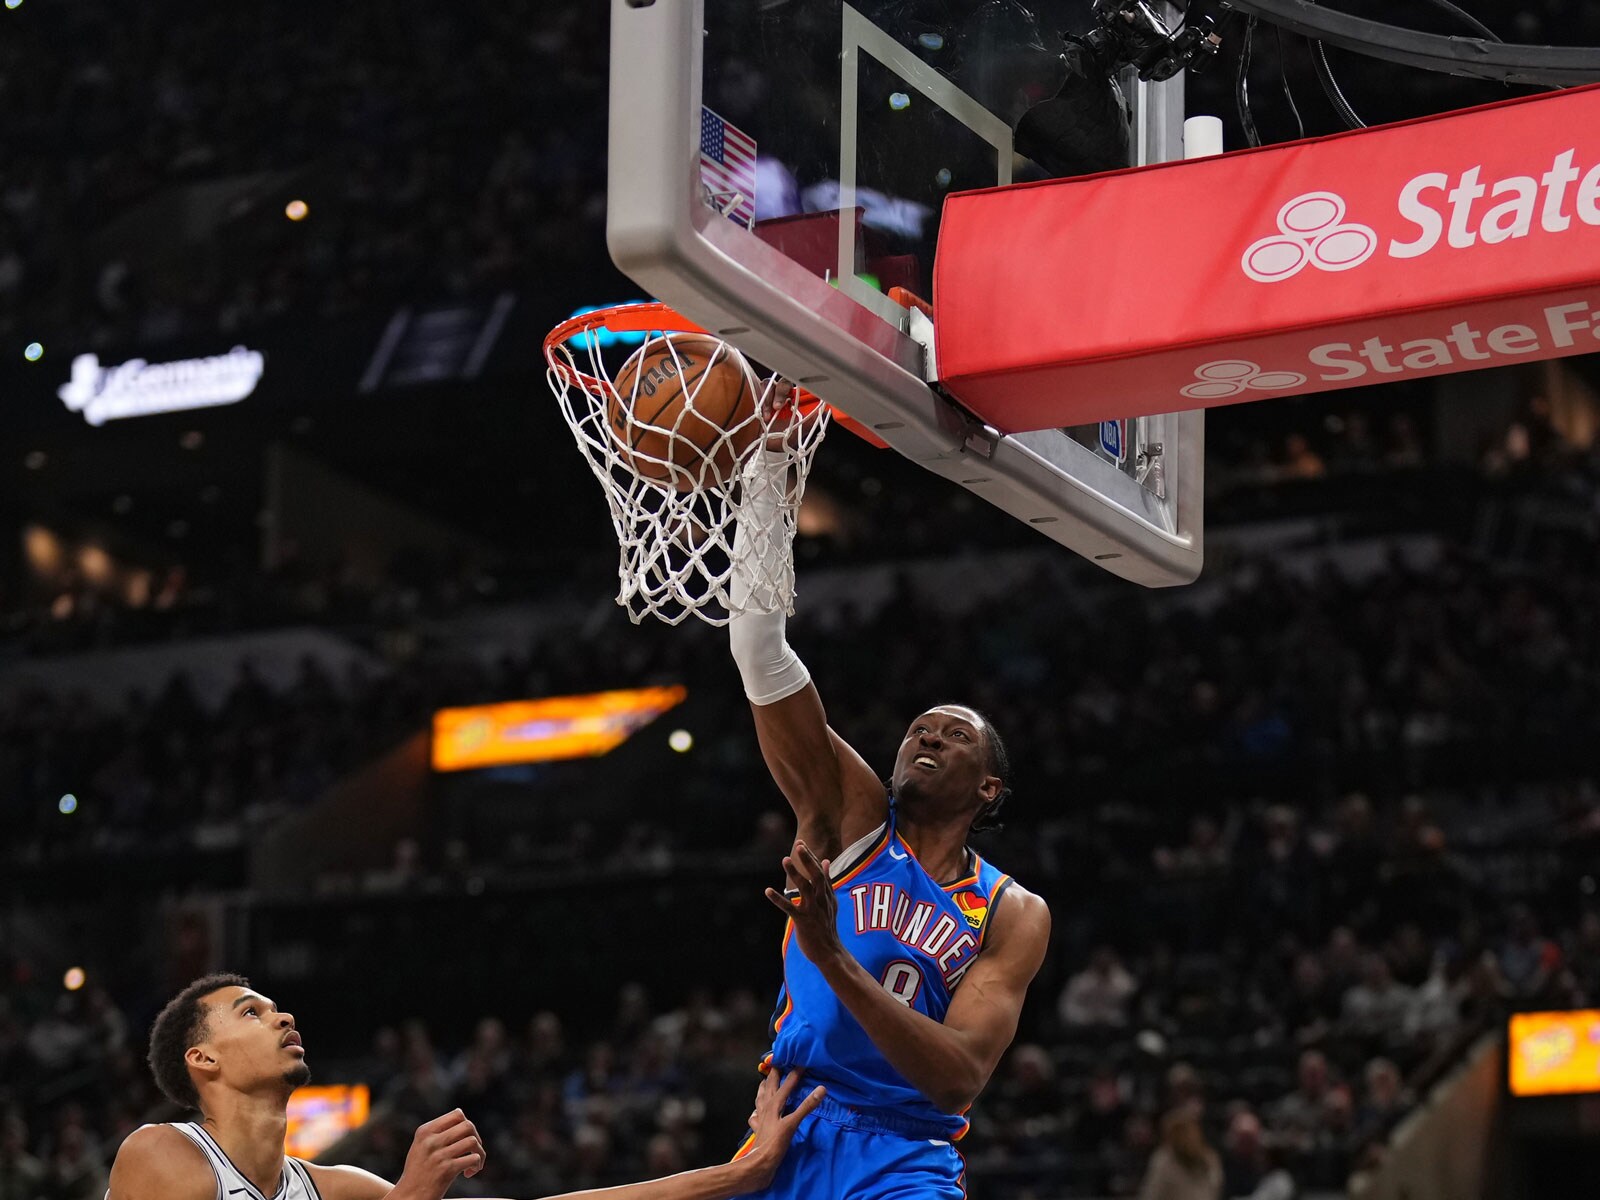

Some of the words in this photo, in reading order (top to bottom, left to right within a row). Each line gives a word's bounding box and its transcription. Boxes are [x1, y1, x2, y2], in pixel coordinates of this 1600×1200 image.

[1308, 321, 1540, 381] State
[1543, 301, 1600, 348] F
[1103, 420, 1117, 449] NBA
